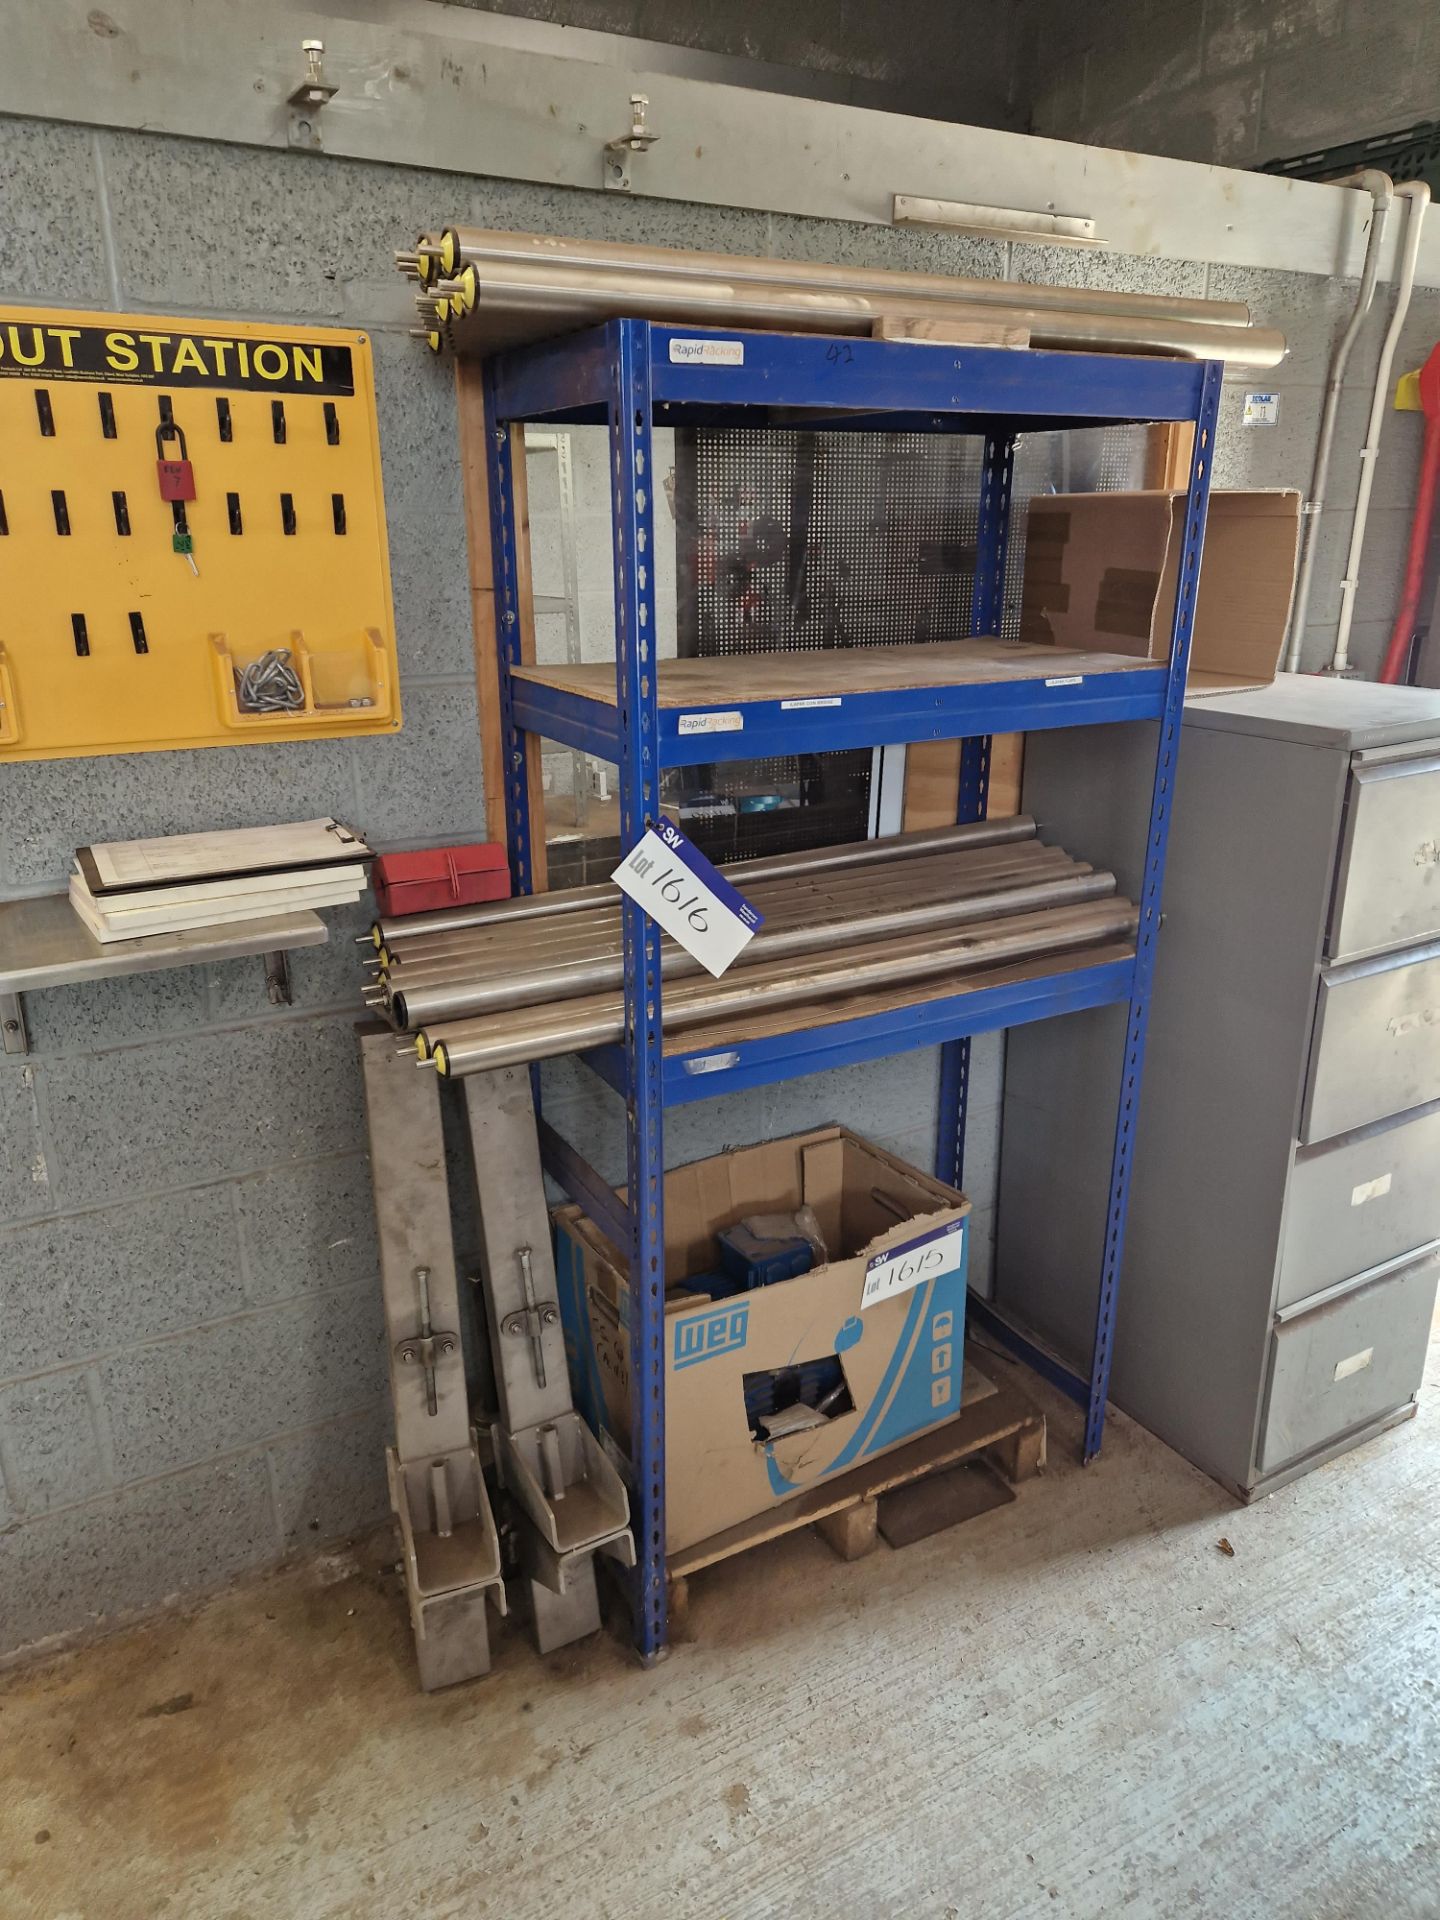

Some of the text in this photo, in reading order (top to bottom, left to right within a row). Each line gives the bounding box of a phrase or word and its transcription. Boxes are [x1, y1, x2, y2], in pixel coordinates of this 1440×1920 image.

[0, 325, 324, 383] UT STATION
[662, 827, 684, 849] SW
[628, 849, 709, 933] Lot 1616
[866, 1248, 944, 1296] Lot 1615
[874, 1251, 890, 1267] SW
